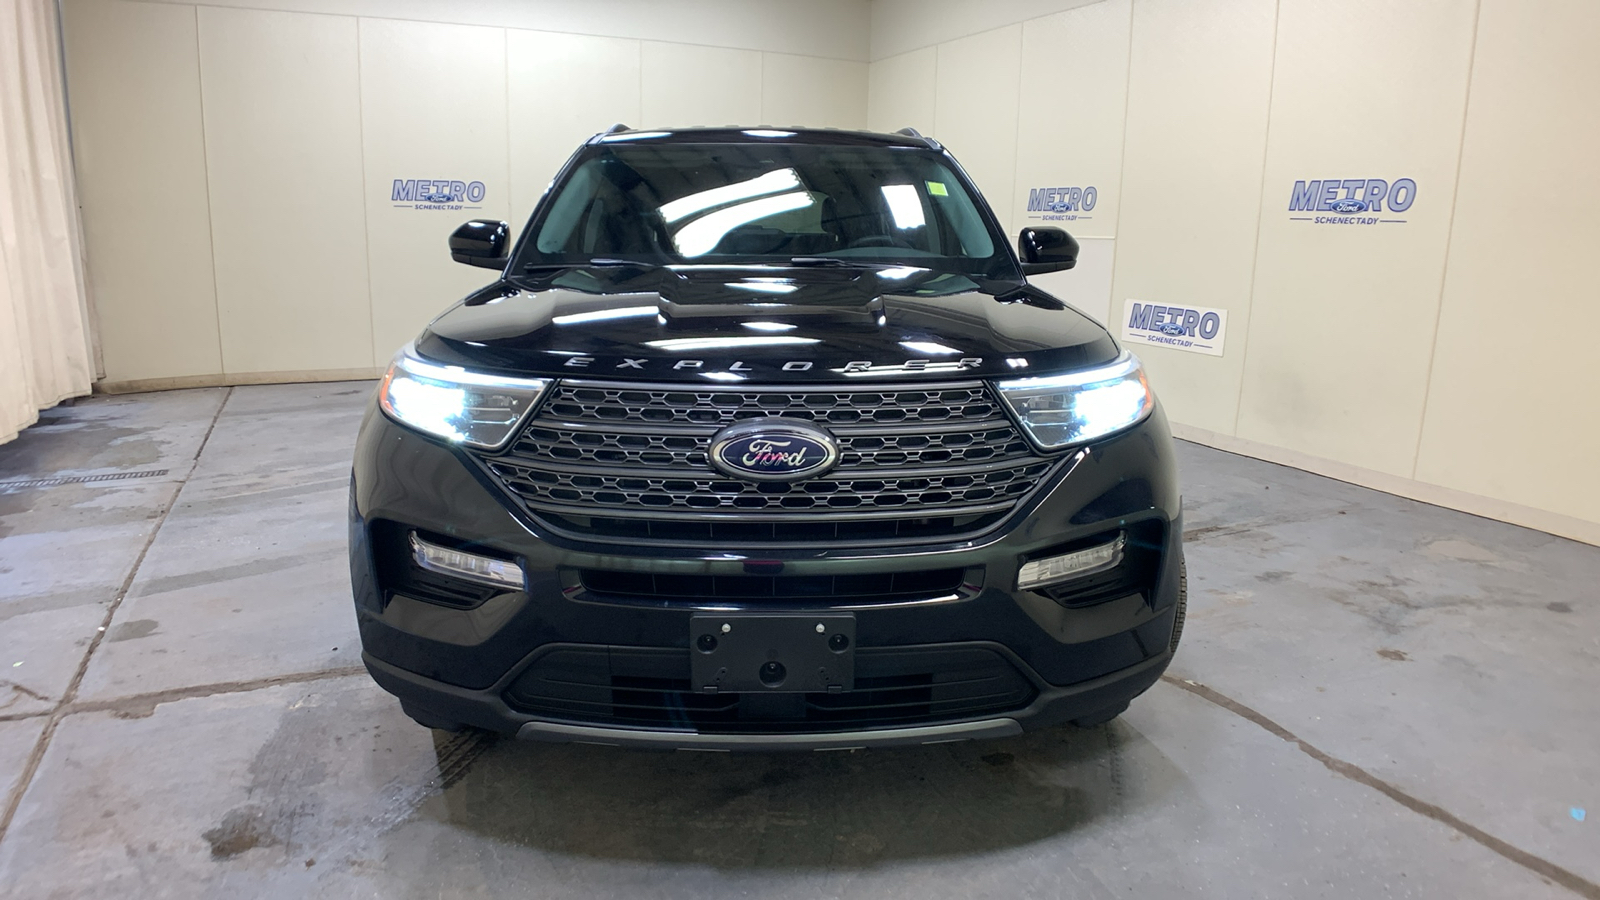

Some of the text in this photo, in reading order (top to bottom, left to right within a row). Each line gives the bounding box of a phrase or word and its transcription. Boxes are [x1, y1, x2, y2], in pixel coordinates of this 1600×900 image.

[391, 179, 486, 202] METRO
[1027, 186, 1098, 212] METRO
[1287, 178, 1417, 213] METRO
[1314, 216, 1380, 225] SCHENECTADY
[1128, 303, 1220, 340] METRO
[1147, 335, 1193, 347] SCHENECTADY
[563, 356, 984, 372] EXPLORER
[742, 439, 806, 467] Ford
